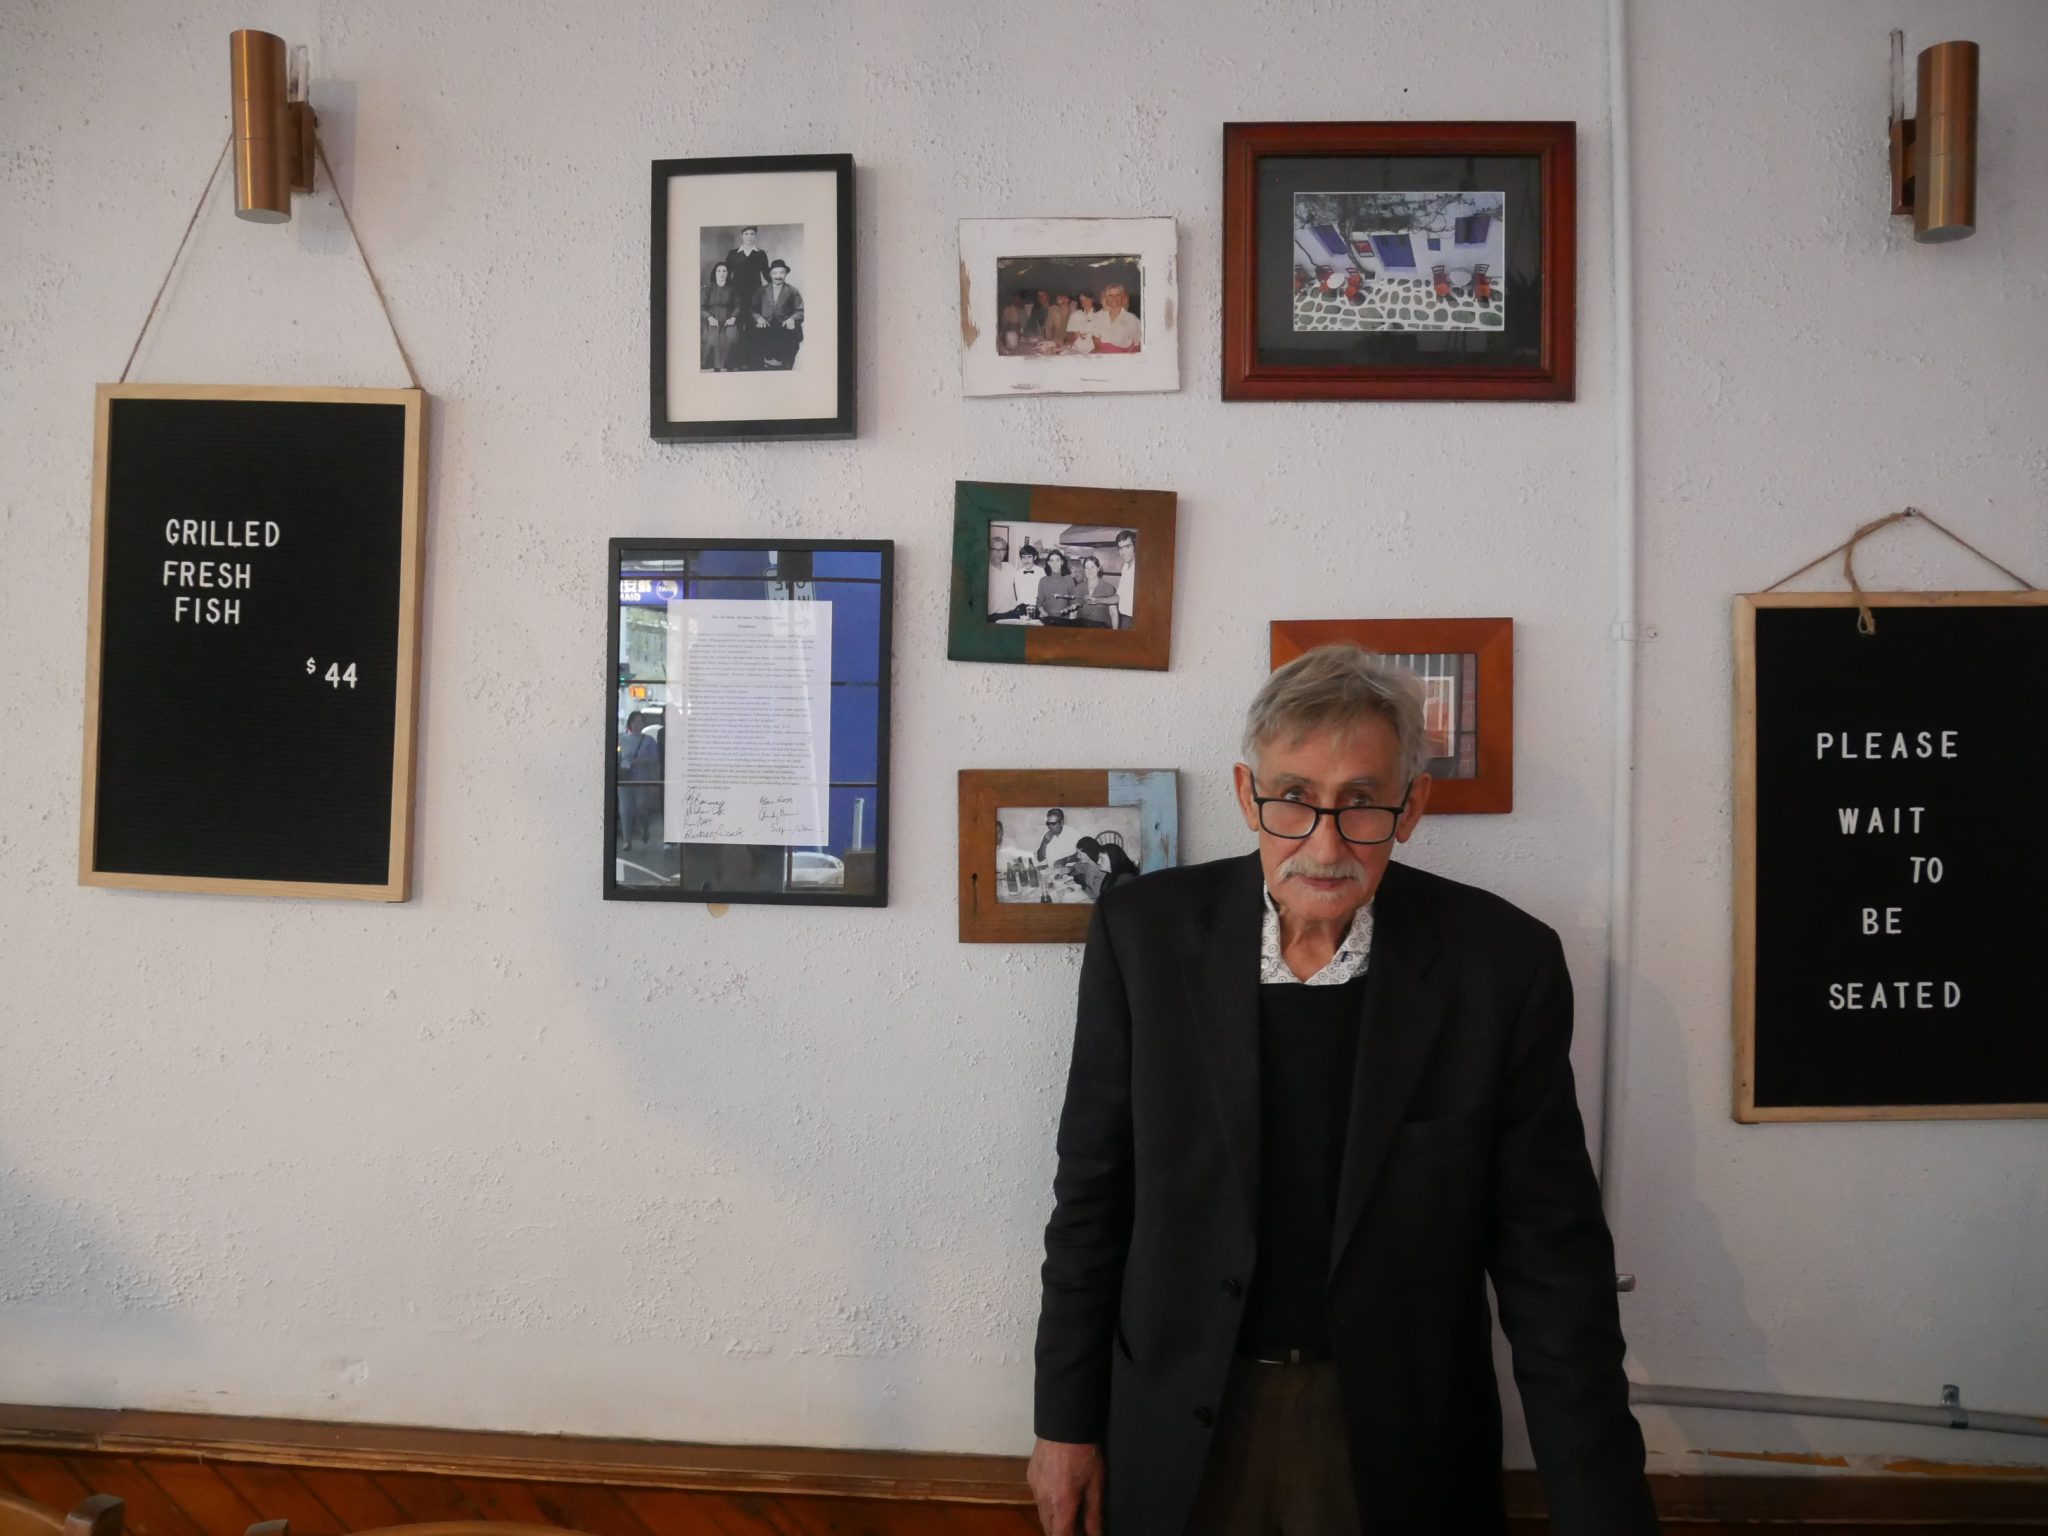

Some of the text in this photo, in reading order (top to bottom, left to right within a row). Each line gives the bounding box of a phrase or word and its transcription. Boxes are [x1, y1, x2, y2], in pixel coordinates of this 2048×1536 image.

[166, 519, 280, 548] GRILLED
[163, 561, 250, 589] FRESH
[175, 597, 240, 624] FISH
[306, 657, 357, 689] $ 44
[1817, 731, 1957, 760] PLEASE
[1839, 807, 1924, 834] WAIT
[1910, 857, 1943, 883] TO
[1863, 908, 1902, 934] BE
[1829, 982, 1960, 1010] SEATED
